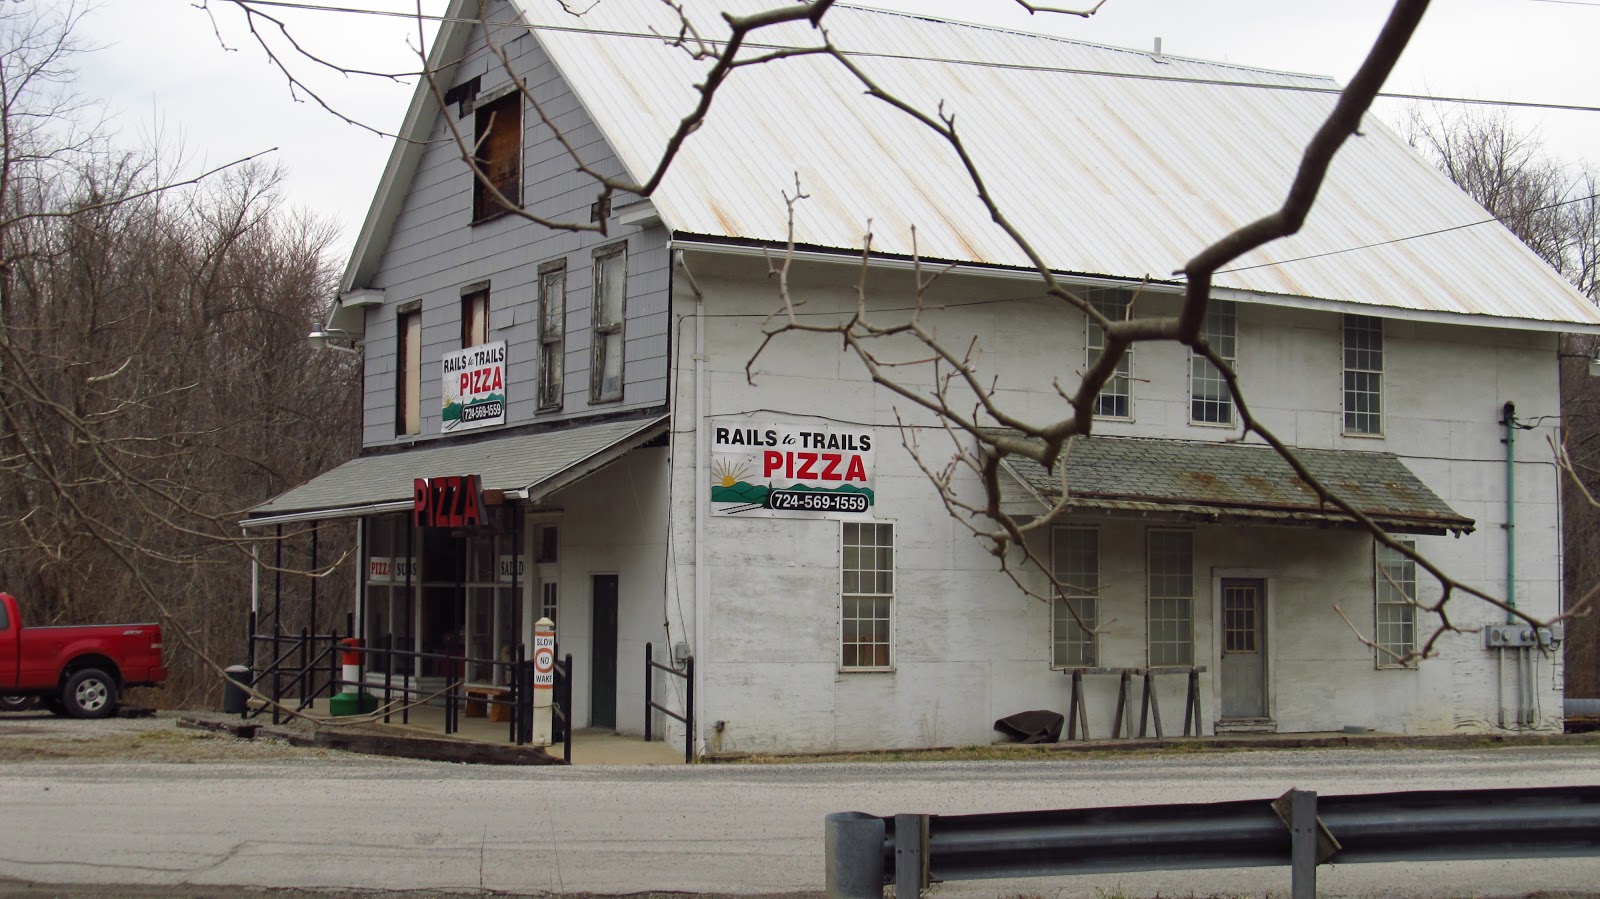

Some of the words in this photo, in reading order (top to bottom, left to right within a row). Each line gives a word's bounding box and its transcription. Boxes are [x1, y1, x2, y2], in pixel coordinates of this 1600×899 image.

[444, 355, 467, 373] RAILS
[475, 347, 504, 366] TRAILS
[460, 366, 502, 396] PIZZA
[464, 403, 501, 420] 724-569-1559
[716, 428, 778, 446] RAILS
[782, 434, 796, 445] to
[800, 432, 871, 451] TRAILS
[763, 451, 867, 482] PIZZA
[414, 474, 480, 528] PIZZA
[775, 494, 866, 510] 724-569-1559
[396, 562, 416, 576] SUS
[501, 560, 523, 576] SALD
[536, 638, 553, 646] SLOW
[540, 656, 550, 665] NO
[536, 674, 552, 683] WAKE
